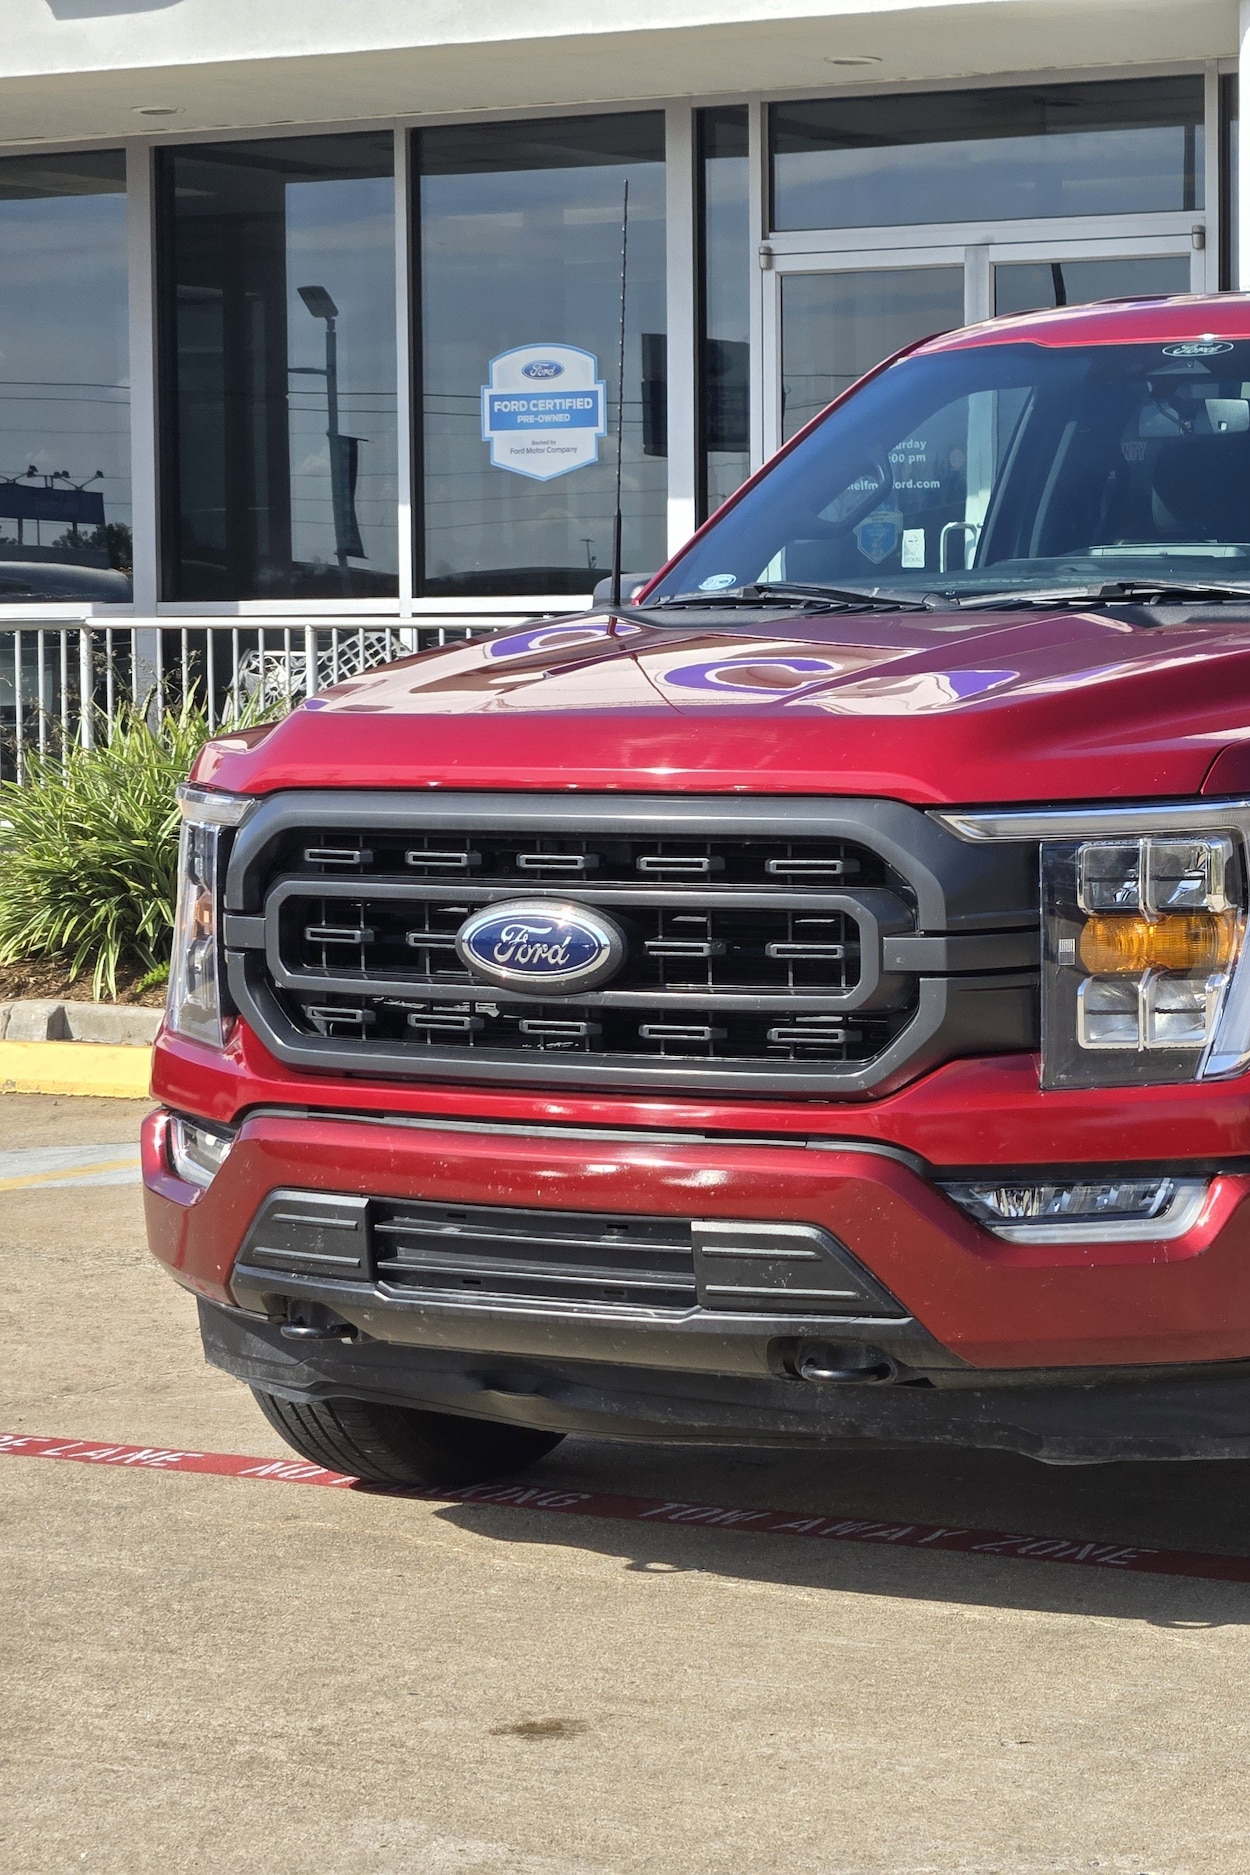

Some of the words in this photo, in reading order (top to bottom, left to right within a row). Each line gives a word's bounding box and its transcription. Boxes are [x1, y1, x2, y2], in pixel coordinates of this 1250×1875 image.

[1173, 343, 1222, 354] Ford
[529, 363, 556, 377] Ford
[493, 400, 528, 413] FORD
[529, 397, 593, 412] CERTIFIED
[517, 413, 571, 424] PRE-OWNED
[510, 447, 525, 455] Ford
[526, 446, 546, 455] Motor
[546, 446, 578, 455] Company
[908, 454, 927, 464] pm
[493, 923, 571, 967] Ford
[37, 1441, 205, 1467] LANE
[236, 1461, 329, 1480] NO
[639, 1502, 772, 1526] TOW
[768, 1517, 970, 1544] AWAY
[971, 1534, 1159, 1565] ZONE
